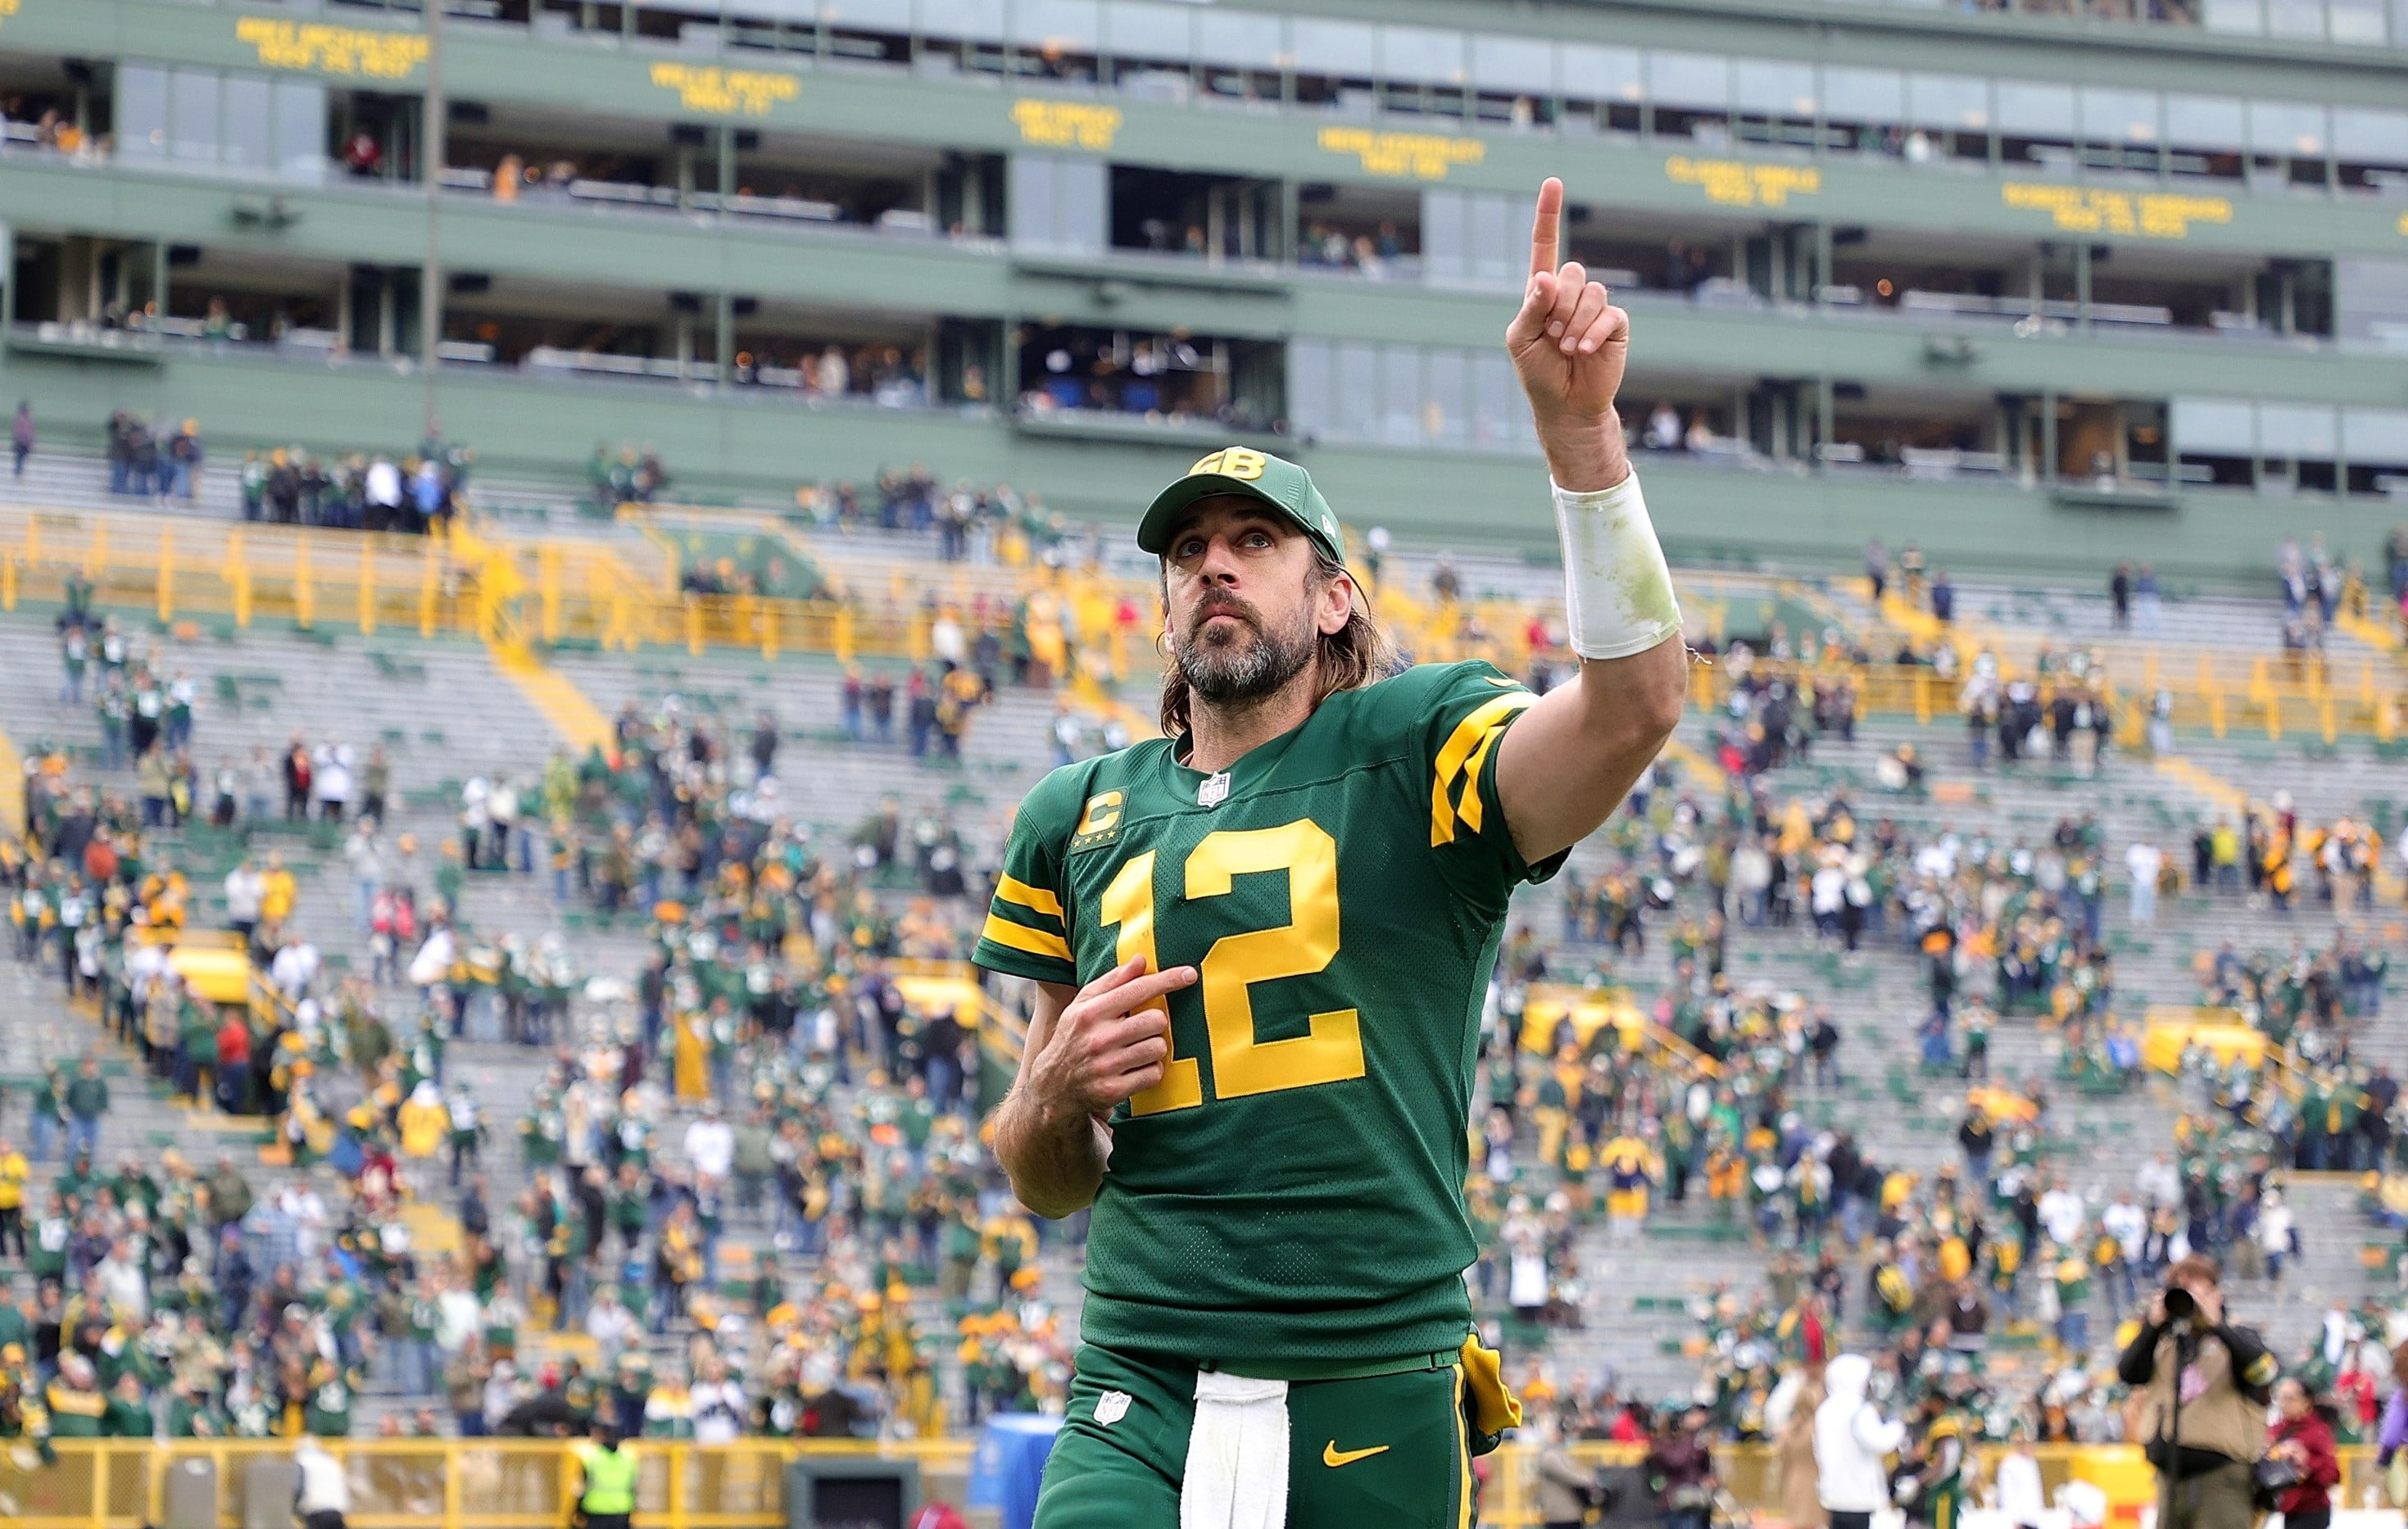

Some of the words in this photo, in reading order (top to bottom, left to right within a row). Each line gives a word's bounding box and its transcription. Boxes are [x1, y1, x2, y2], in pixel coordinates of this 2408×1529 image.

[1188, 447, 1266, 480] GB
[1203, 786, 1223, 801] NFL
[1077, 791, 1122, 836] C
[1100, 818, 1366, 1117] 12
